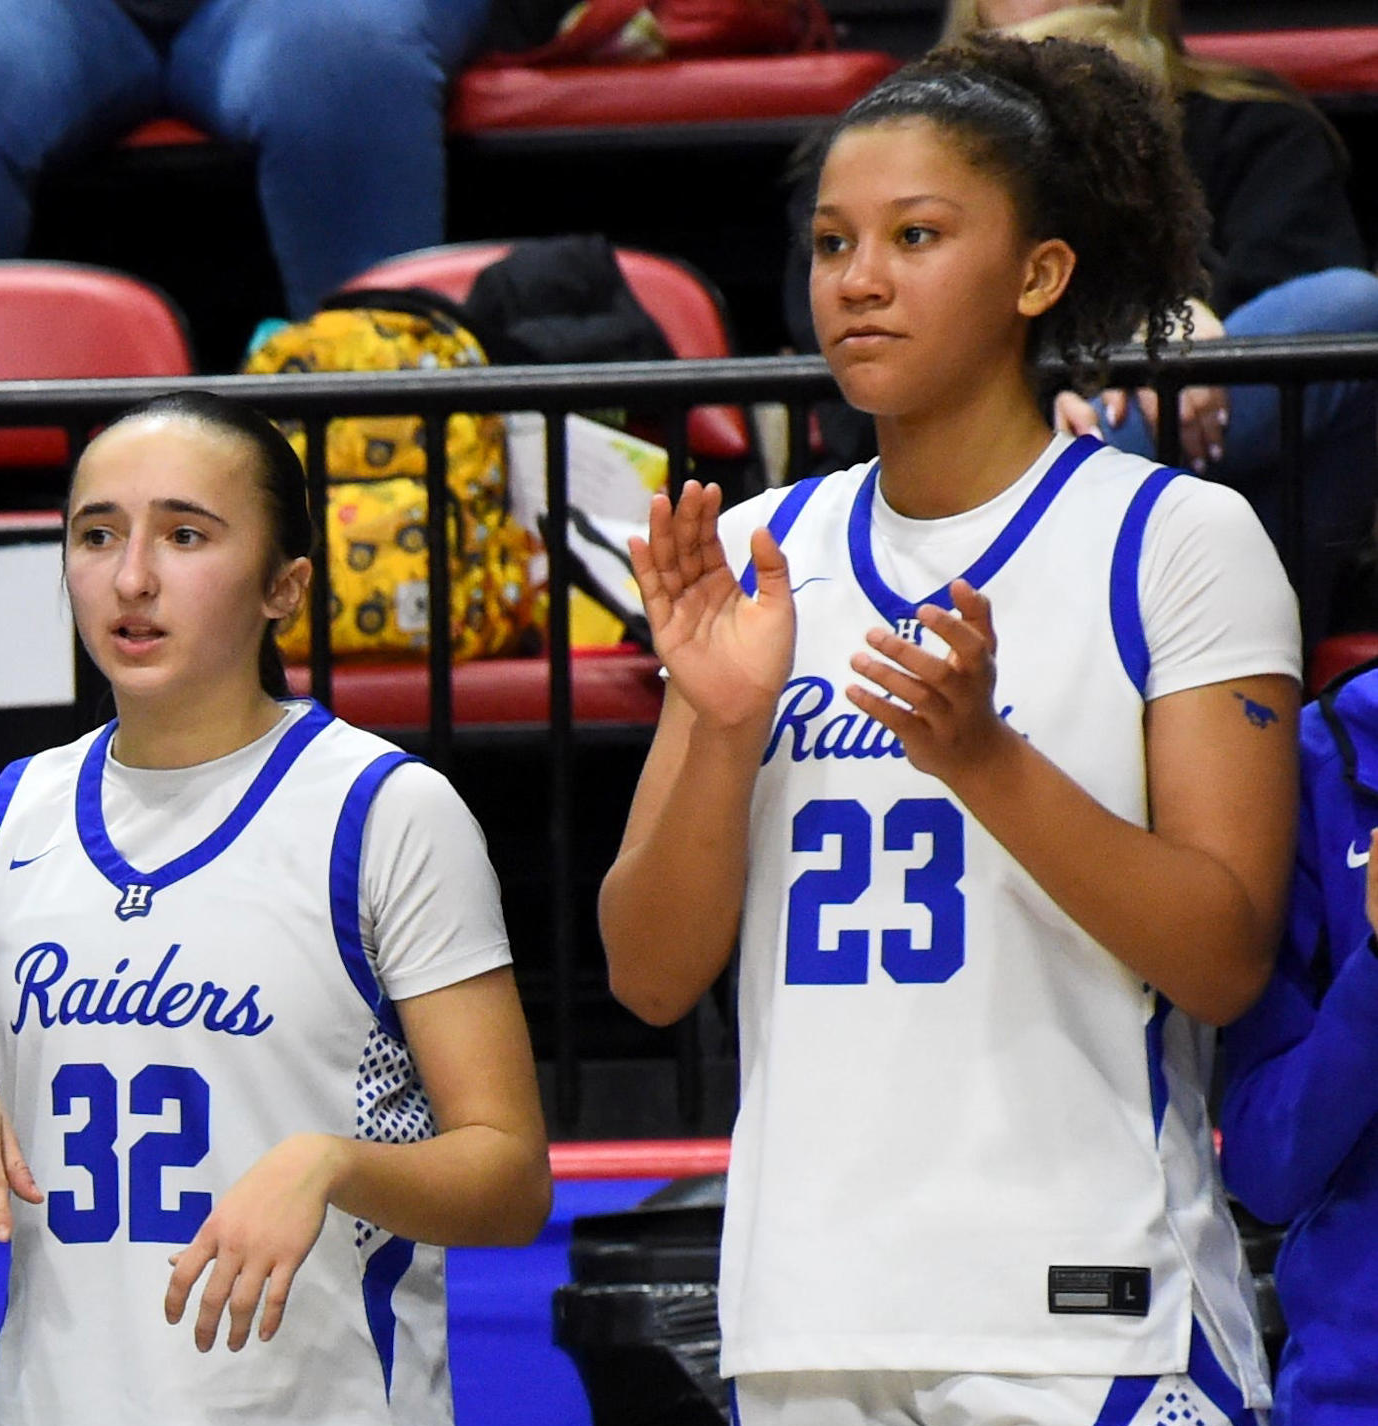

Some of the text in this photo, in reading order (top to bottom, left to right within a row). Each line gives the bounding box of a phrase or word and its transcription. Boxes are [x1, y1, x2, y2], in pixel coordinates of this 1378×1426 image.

[120, 884, 152, 908] H
[785, 797, 965, 985] 23
[10, 942, 274, 1037] Raiders
[47, 1062, 213, 1244] 32
